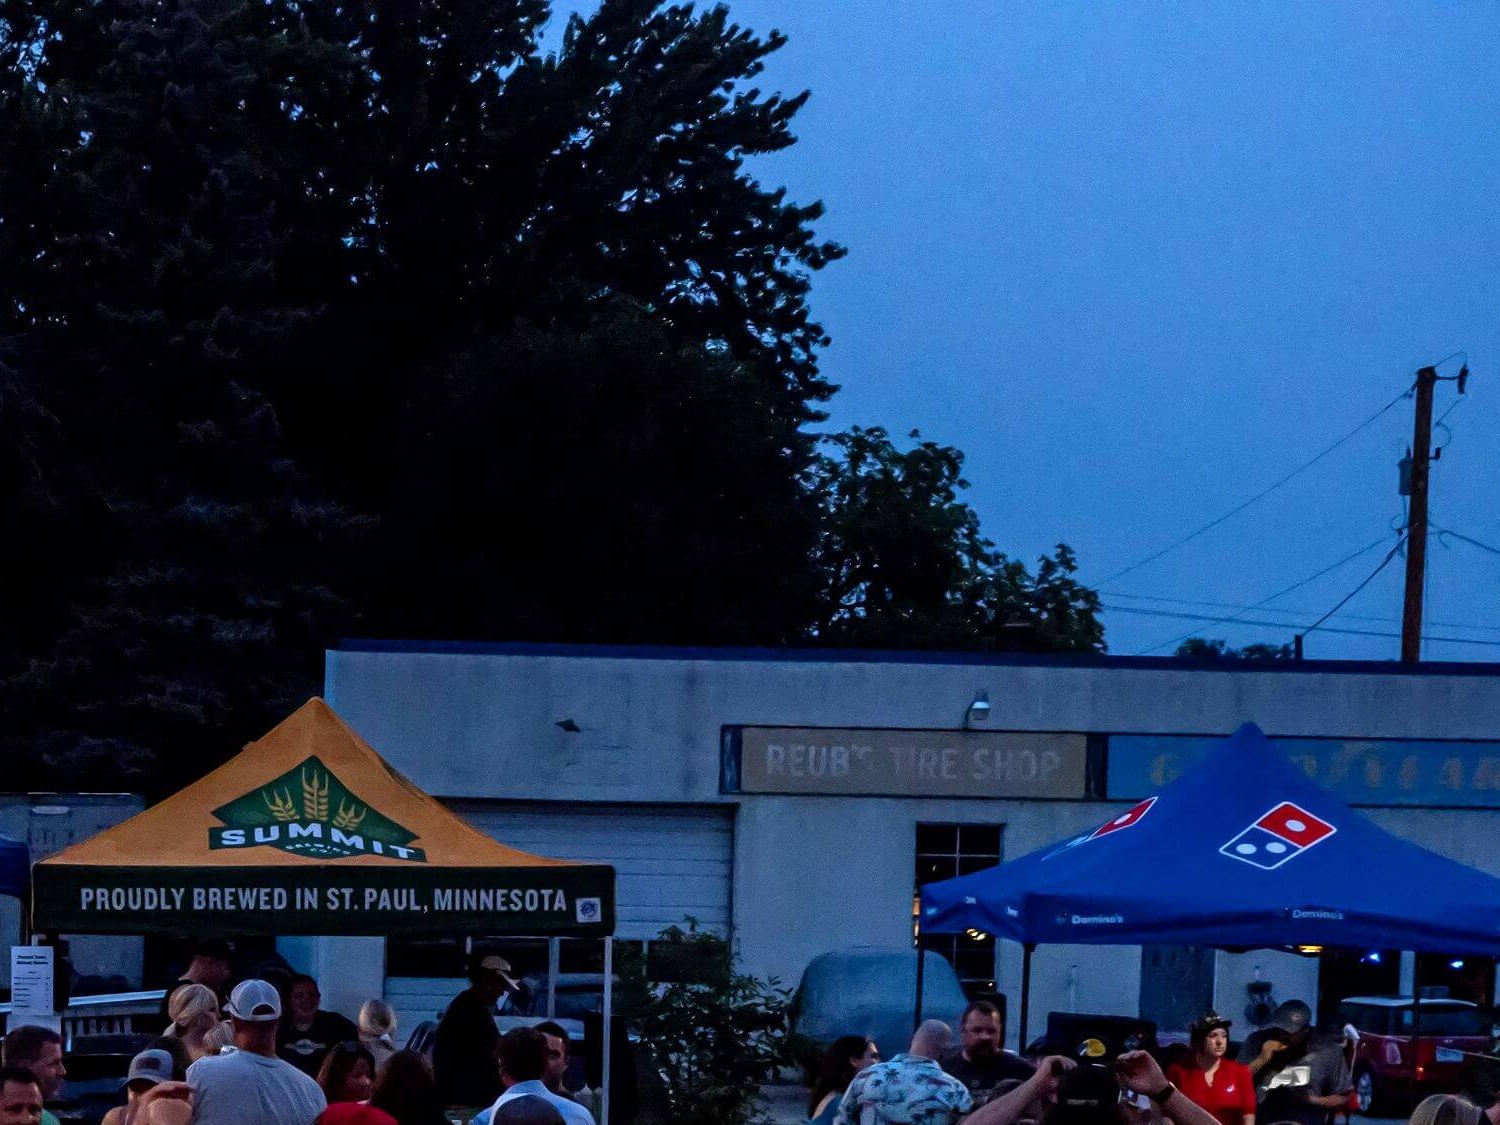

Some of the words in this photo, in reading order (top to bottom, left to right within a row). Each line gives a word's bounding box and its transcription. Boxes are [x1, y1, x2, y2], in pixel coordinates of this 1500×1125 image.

[972, 748, 1062, 782] SHOP
[220, 822, 415, 859] SUMMIT
[80, 887, 185, 911] PROUDLY
[192, 887, 288, 911] BREWED
[295, 887, 318, 911] IN
[326, 887, 359, 911] ST.
[364, 887, 429, 915] PAUL,
[433, 888, 568, 912] MINNESOTA
[1292, 908, 1344, 920] Domino's
[1071, 913, 1124, 925] Domino's
